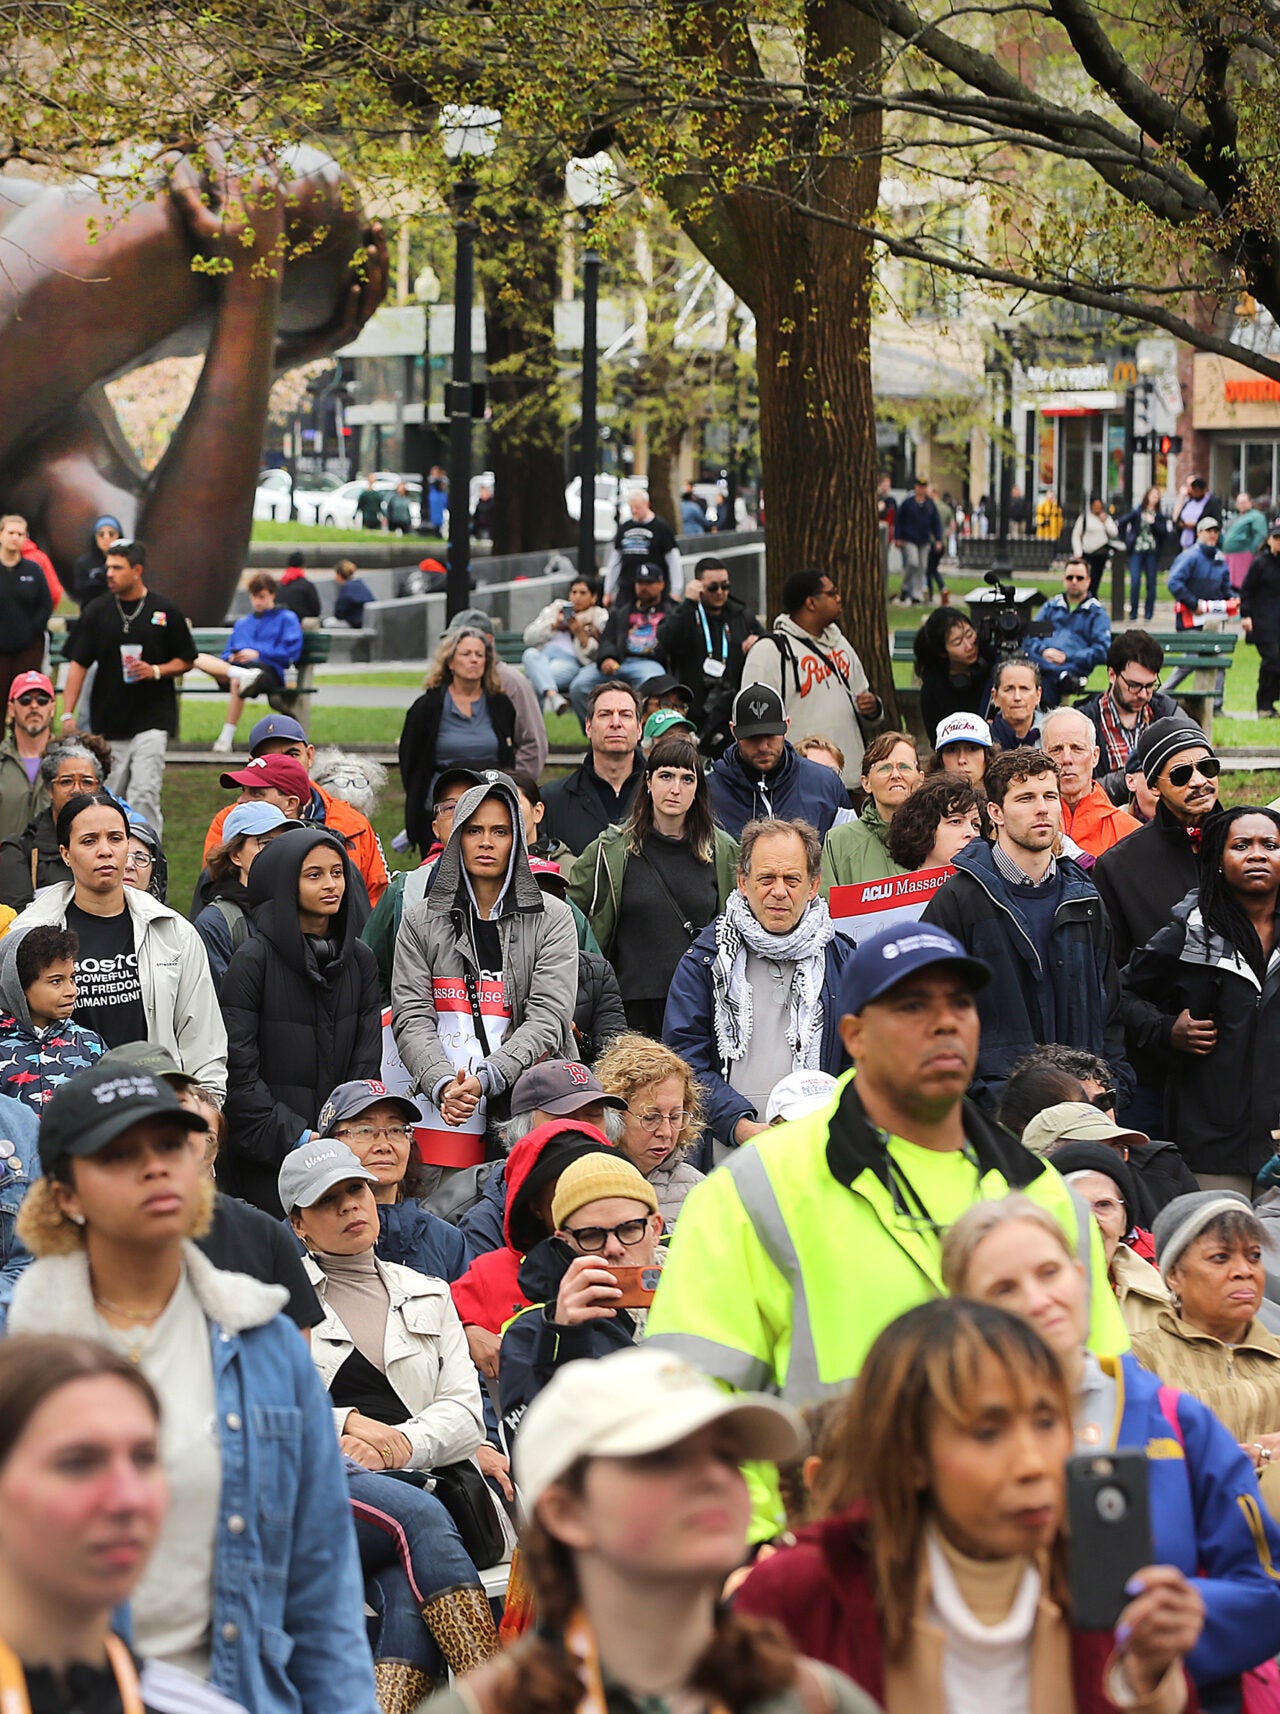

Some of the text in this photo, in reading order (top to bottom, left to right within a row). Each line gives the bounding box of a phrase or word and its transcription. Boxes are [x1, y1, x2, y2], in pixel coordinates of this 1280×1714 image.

[861, 869, 955, 903] ACLU Massach
[563, 1063, 589, 1085] B
